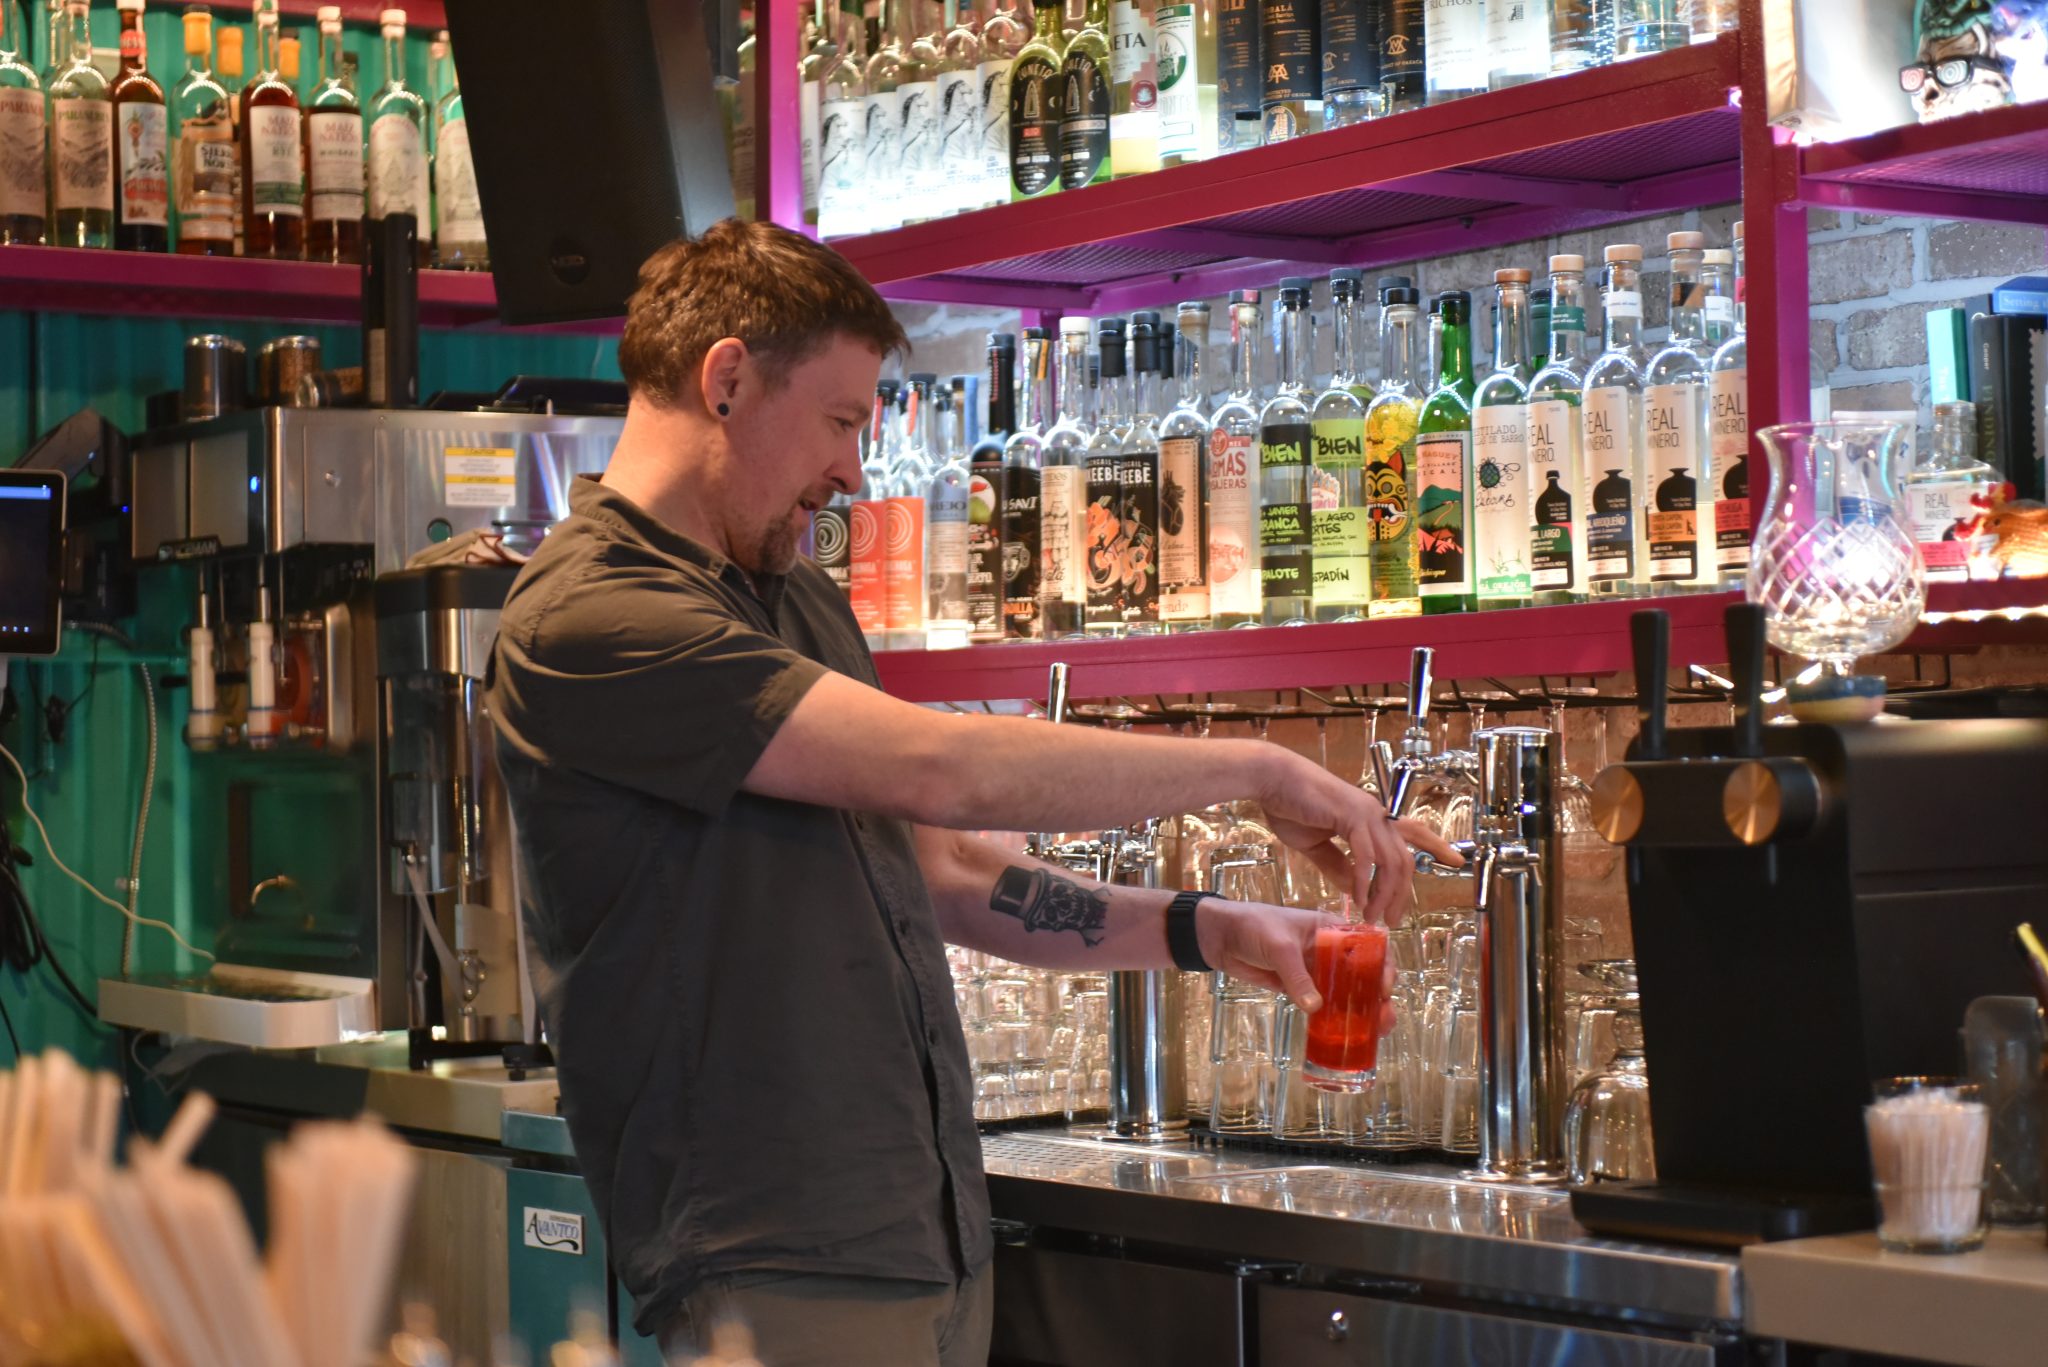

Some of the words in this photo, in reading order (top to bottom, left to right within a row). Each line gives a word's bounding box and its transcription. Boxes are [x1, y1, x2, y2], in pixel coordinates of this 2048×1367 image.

[1113, 31, 1147, 51] ETA
[1261, 441, 1303, 463] BIEN
[1318, 435, 1362, 456] BIEN
[1924, 493, 1951, 509] REAL
[1327, 511, 1356, 523] AGEO
